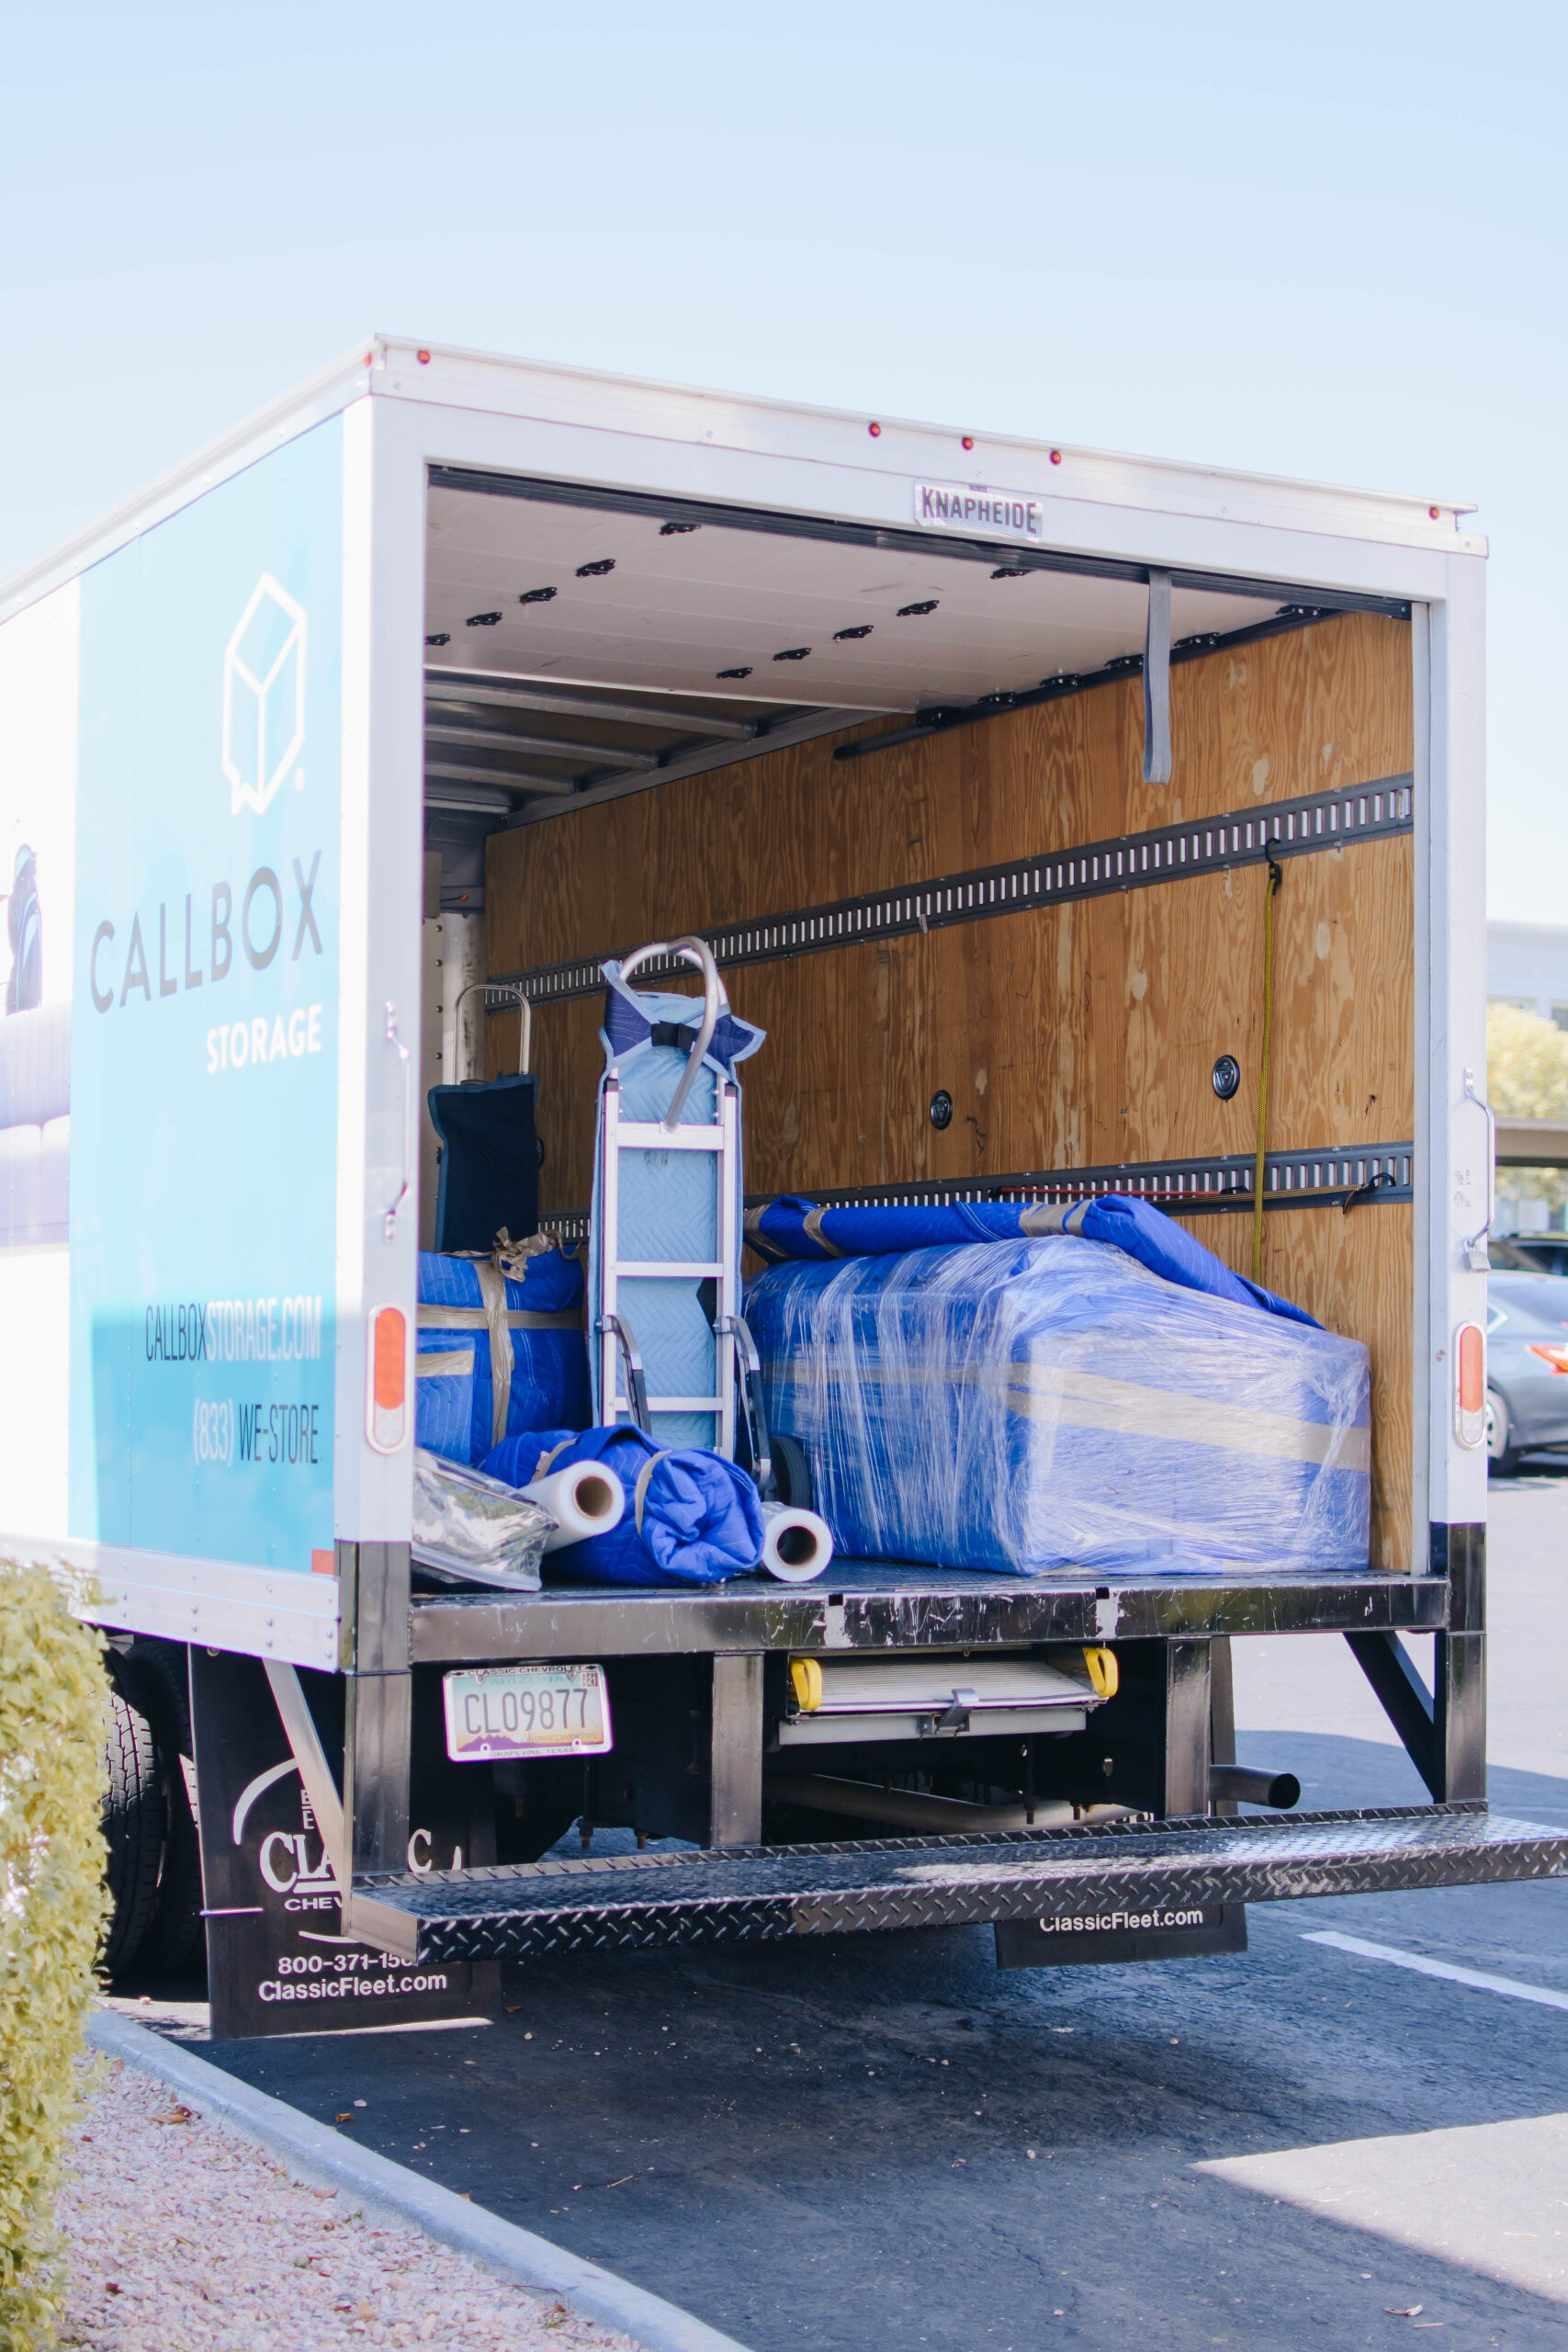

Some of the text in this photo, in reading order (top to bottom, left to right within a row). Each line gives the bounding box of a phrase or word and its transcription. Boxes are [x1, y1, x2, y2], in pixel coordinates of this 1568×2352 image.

[921, 486, 1037, 535] KNAPHEIDE
[90, 849, 323, 1013] CALLBOX
[207, 1004, 322, 1073] STORAGE
[145, 1295, 321, 1361] CALLBOXSTORAGE.COM
[193, 1397, 319, 1467] (833) WE-STORE
[490, 1675, 565, 1685] ARIZONA
[519, 1665, 582, 1673] CHEVROLET
[1040, 1909, 1203, 1932] ClassicFleet.com
[259, 1974, 447, 2001] ClassicFleet.com
